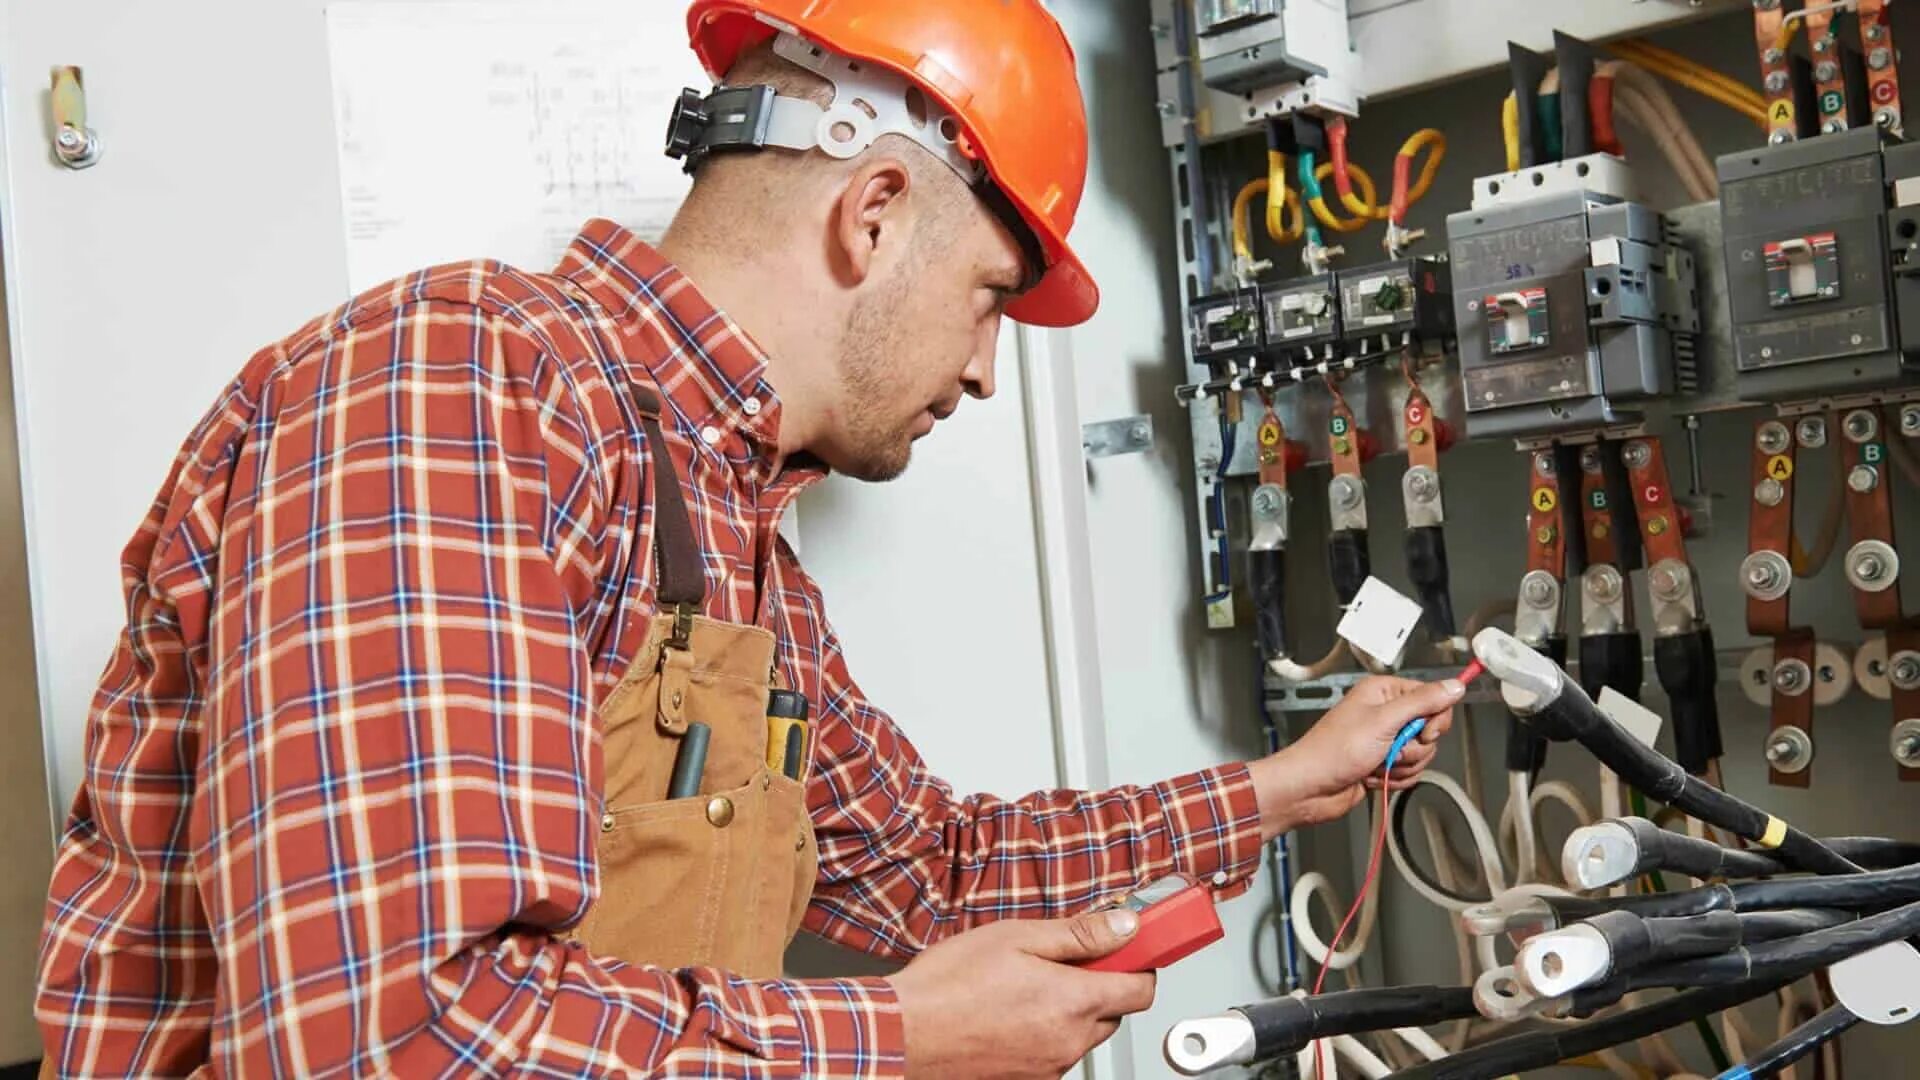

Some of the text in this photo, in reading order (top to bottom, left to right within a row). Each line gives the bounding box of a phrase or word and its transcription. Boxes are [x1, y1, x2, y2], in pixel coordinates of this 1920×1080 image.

[1875, 82, 1889, 101] C
[1824, 94, 1839, 112] B
[1775, 103, 1789, 120] A
[1408, 407, 1422, 423] C
[1332, 417, 1345, 433] B
[1264, 427, 1275, 441] A
[1865, 445, 1880, 461] B
[1773, 459, 1787, 475] A
[1538, 491, 1552, 507] A
[1592, 491, 1606, 507] B
[1645, 486, 1658, 502] C
